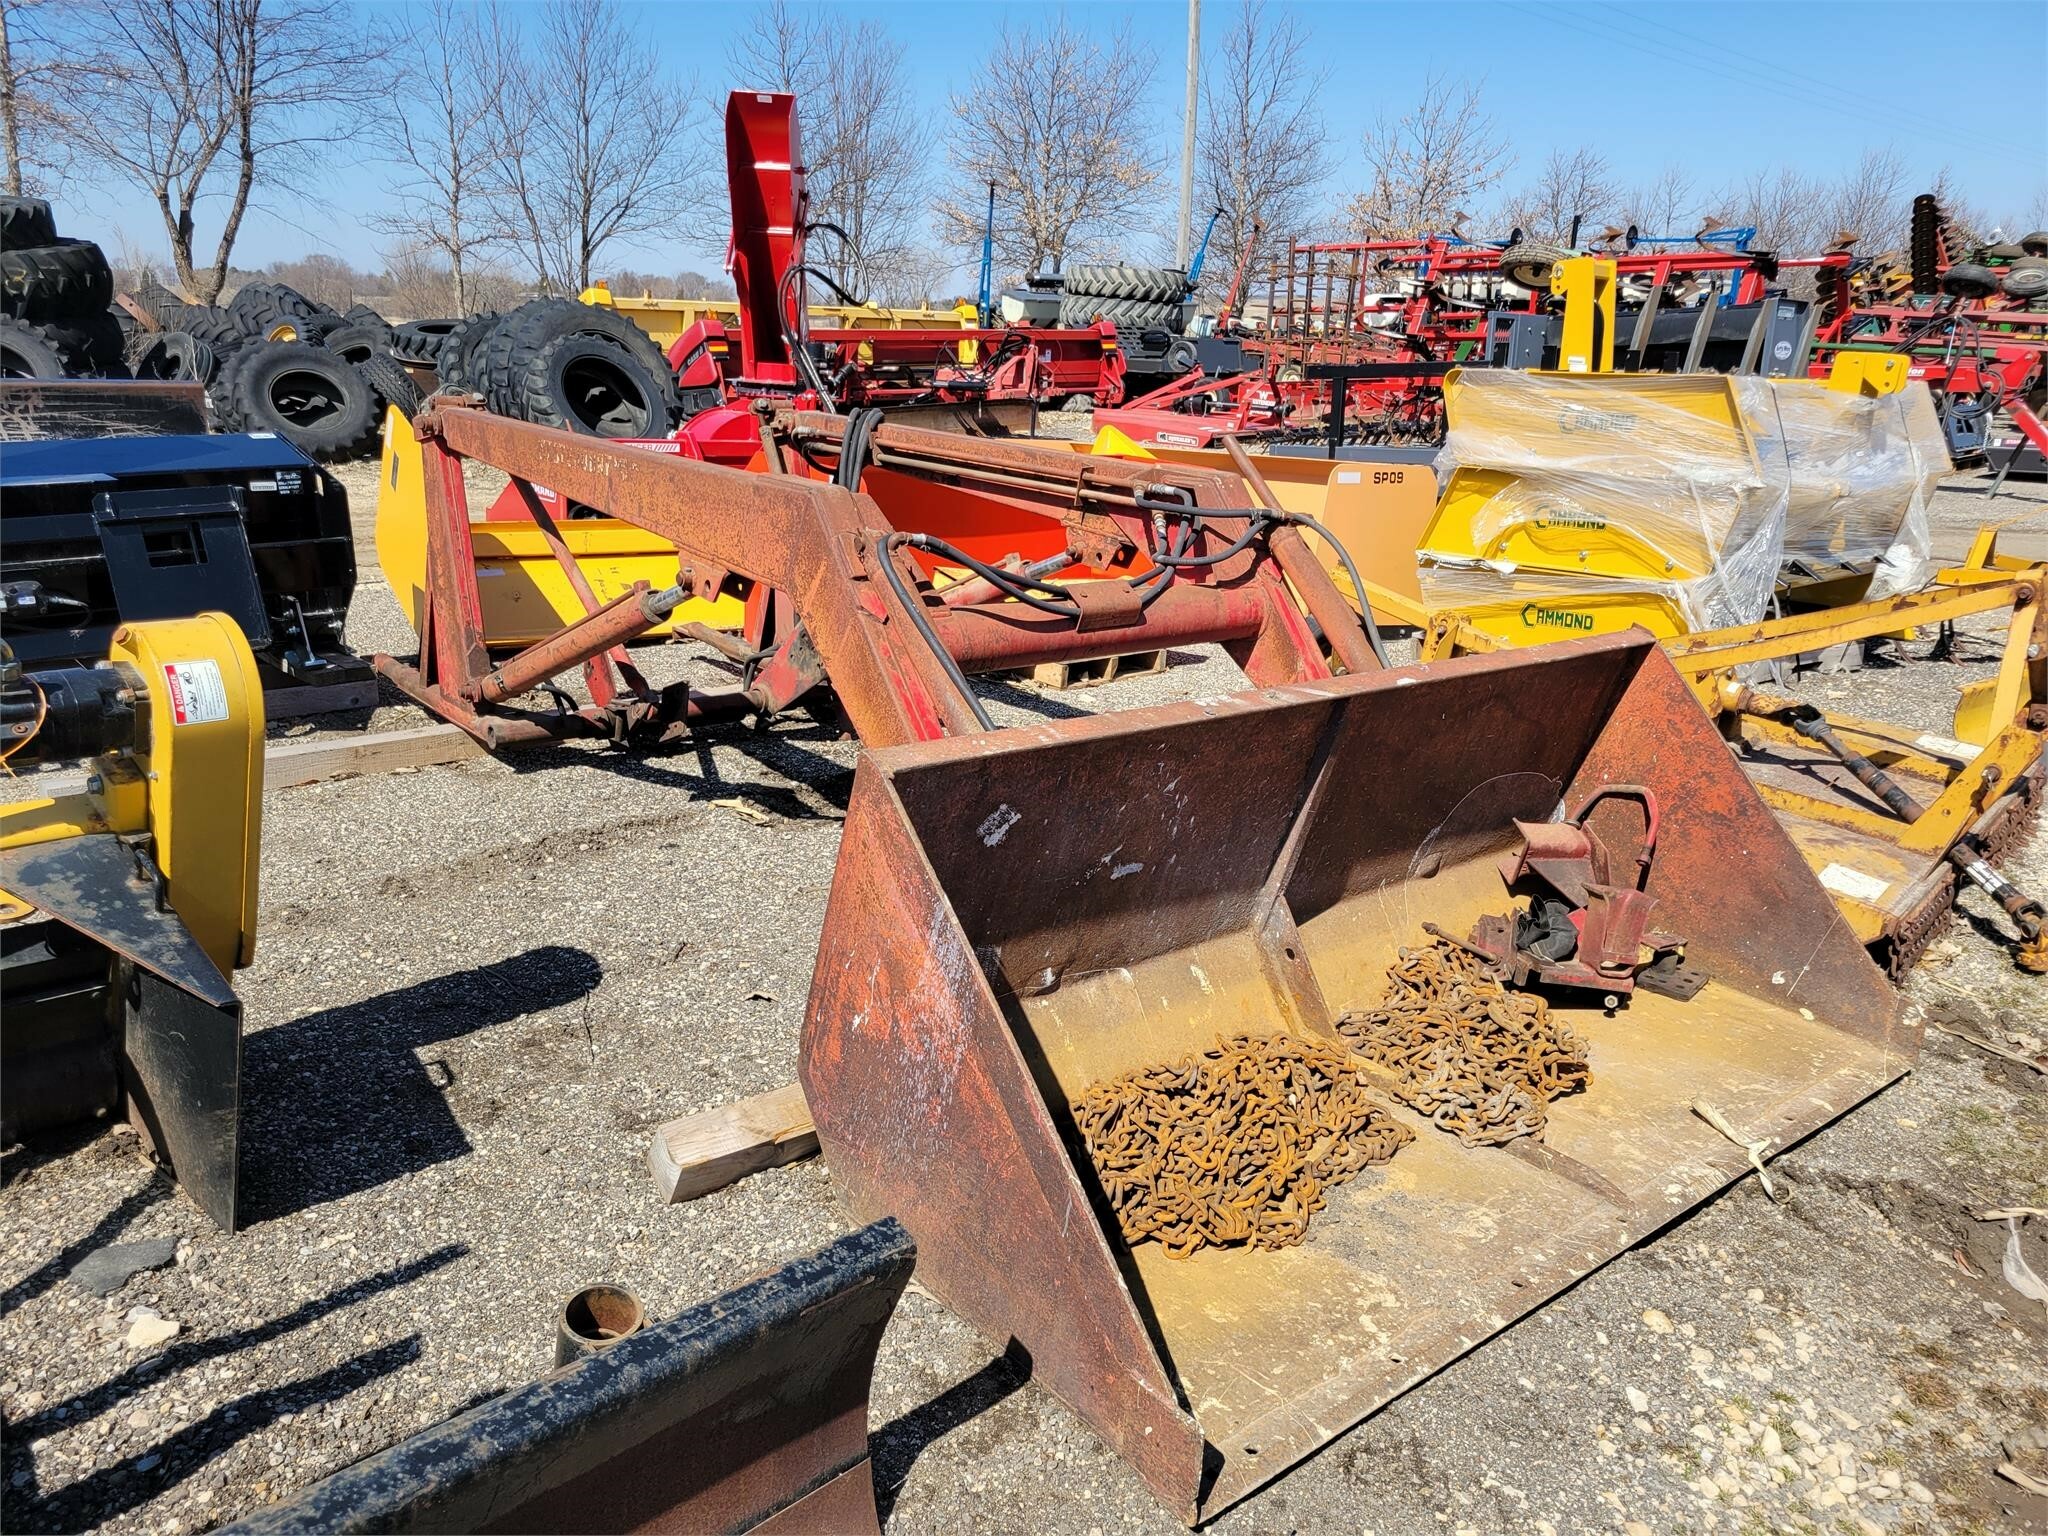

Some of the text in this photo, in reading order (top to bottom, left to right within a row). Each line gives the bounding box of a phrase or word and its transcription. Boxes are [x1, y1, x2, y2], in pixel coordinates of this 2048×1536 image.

[1907, 367, 1926, 377] ion
[1373, 471, 1404, 485] SP09
[1520, 602, 1595, 631] CAMMOND
[169, 674, 184, 705] DANGER
